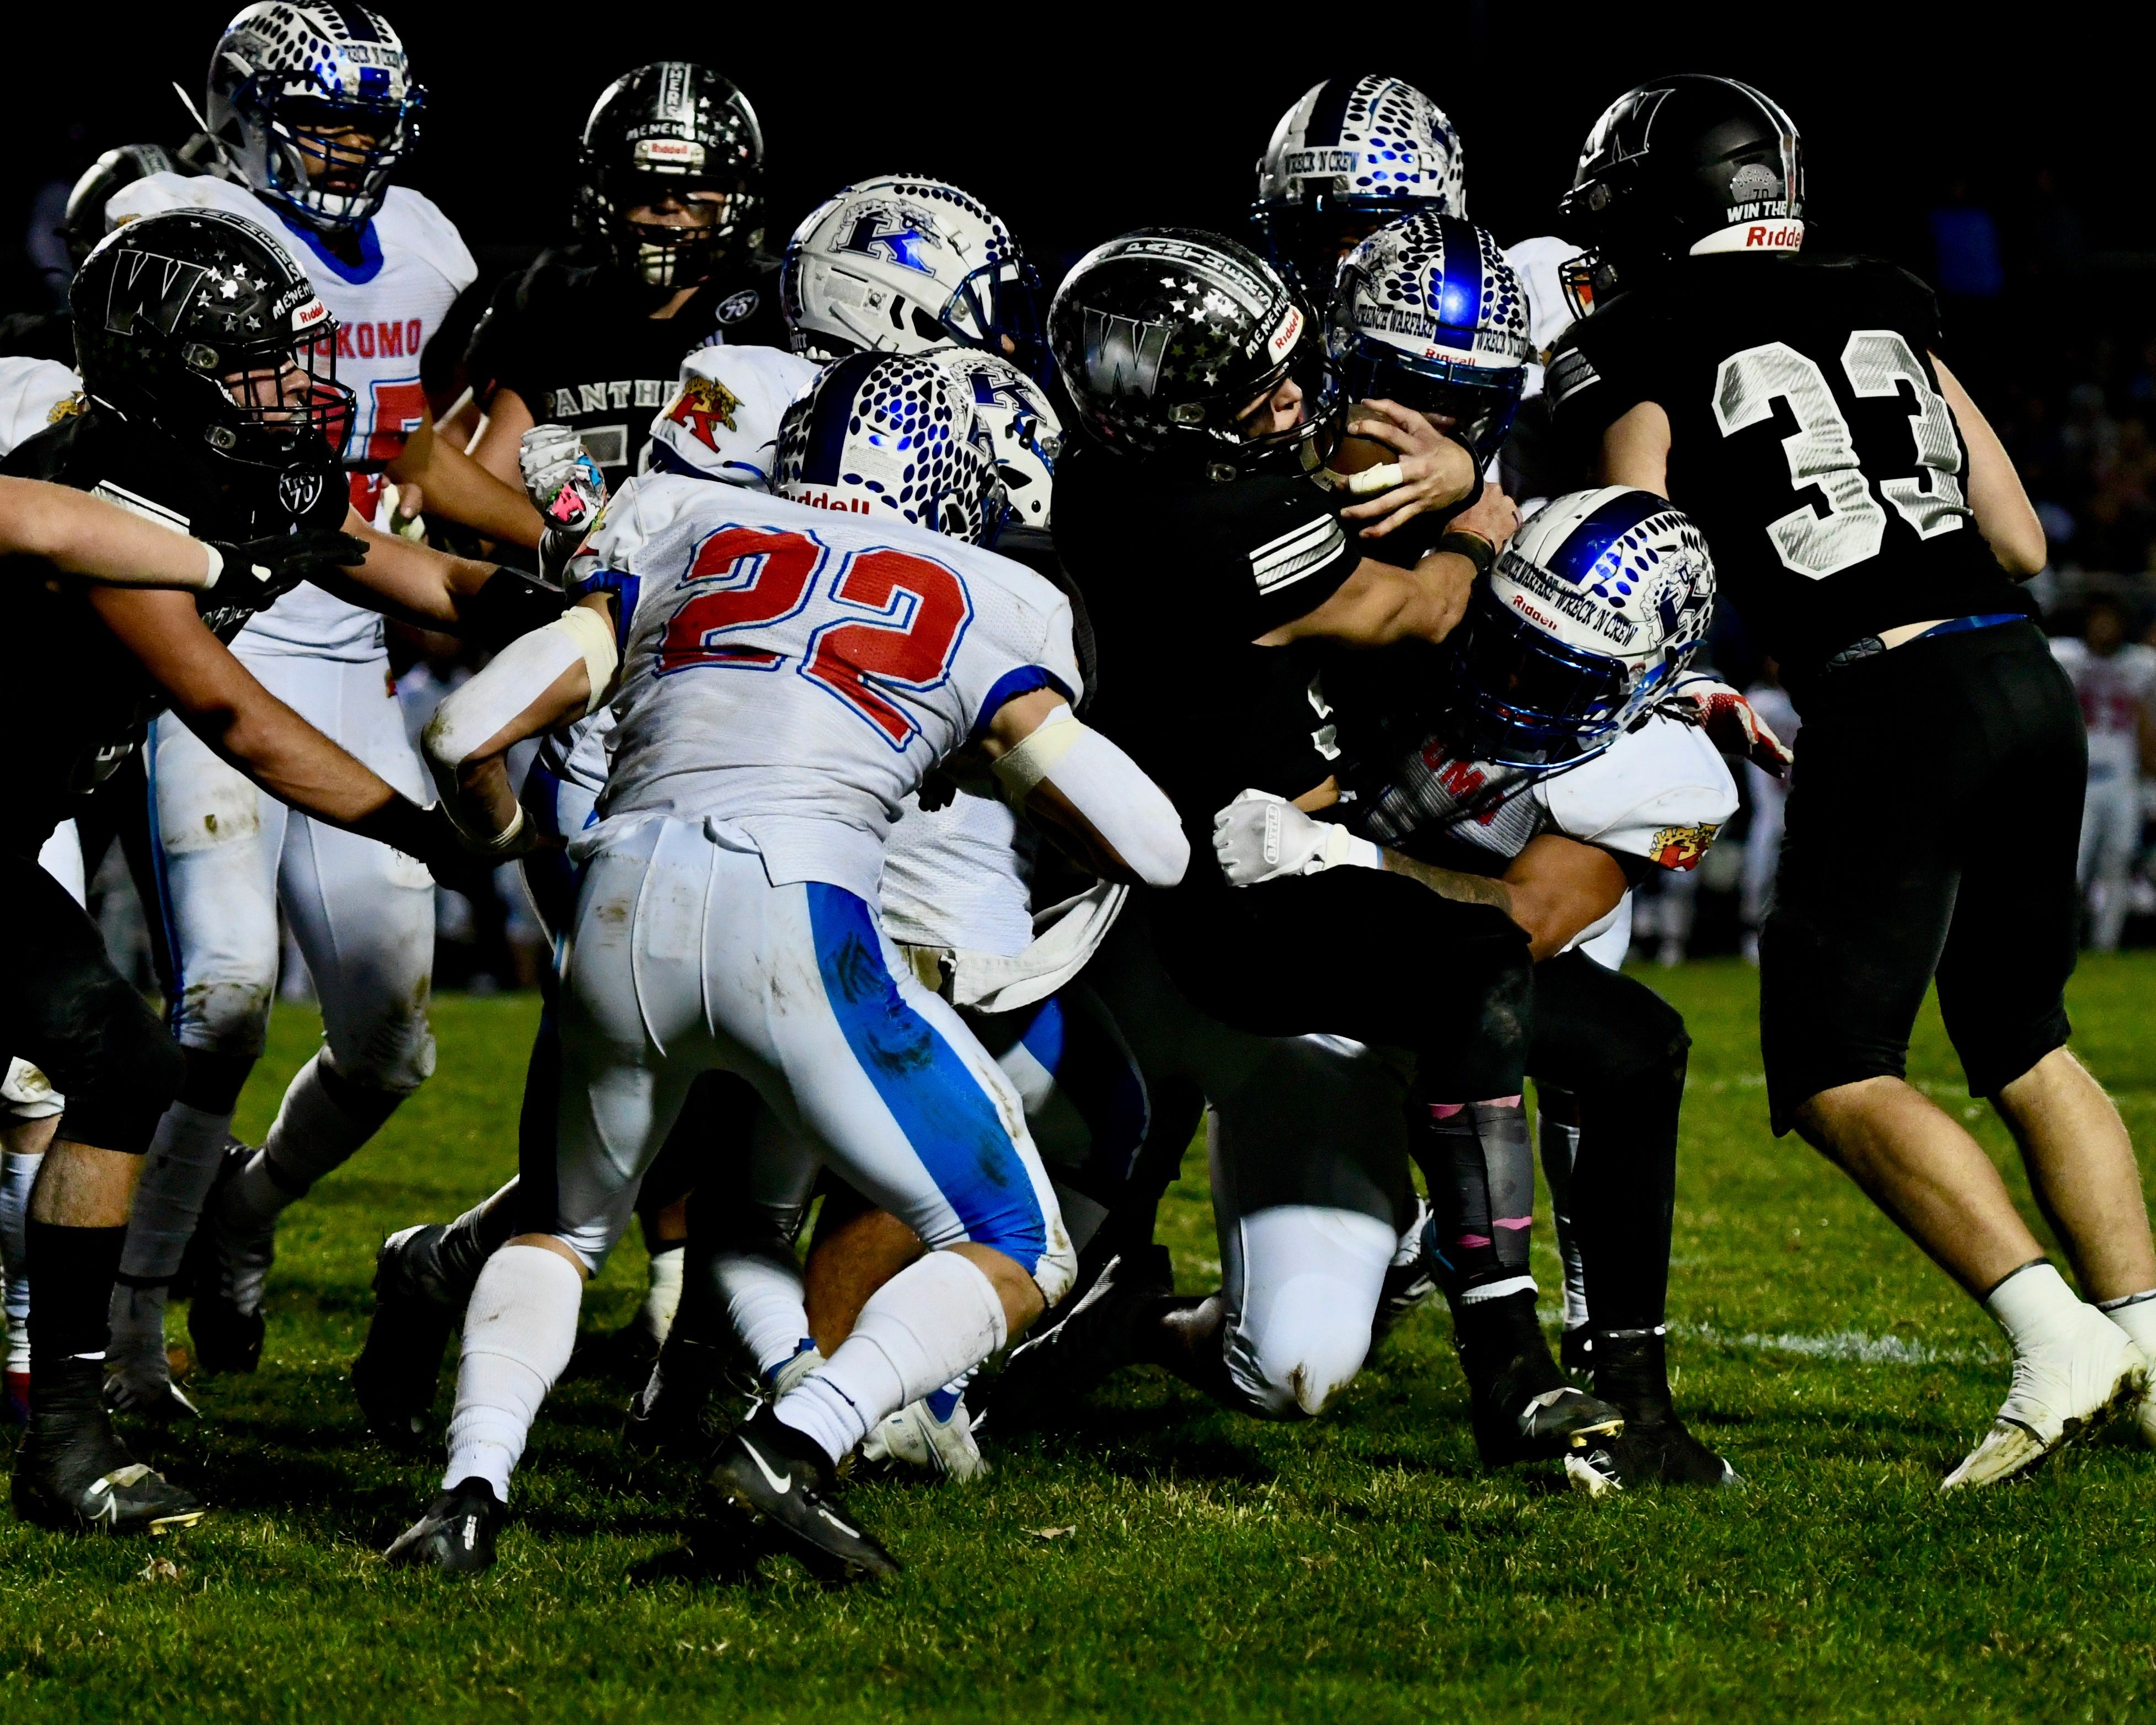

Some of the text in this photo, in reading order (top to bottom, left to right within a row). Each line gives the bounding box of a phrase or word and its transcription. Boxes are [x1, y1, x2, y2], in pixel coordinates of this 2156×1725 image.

[1727, 202, 1760, 223] WIN
[1762, 200, 1787, 218] THE
[837, 216, 937, 279] K
[1125, 241, 1272, 311] PANTHERS
[104, 249, 211, 337] W
[299, 318, 423, 359] OKOMO
[1083, 305, 1172, 399] W
[1275, 309, 1299, 349] Riddell
[1711, 329, 1964, 581] 33
[290, 484, 313, 510] 70
[778, 490, 870, 515] ddell
[651, 522, 975, 754] 22
[1554, 590, 1597, 626] WRECK
[1603, 613, 1639, 647] CREW
